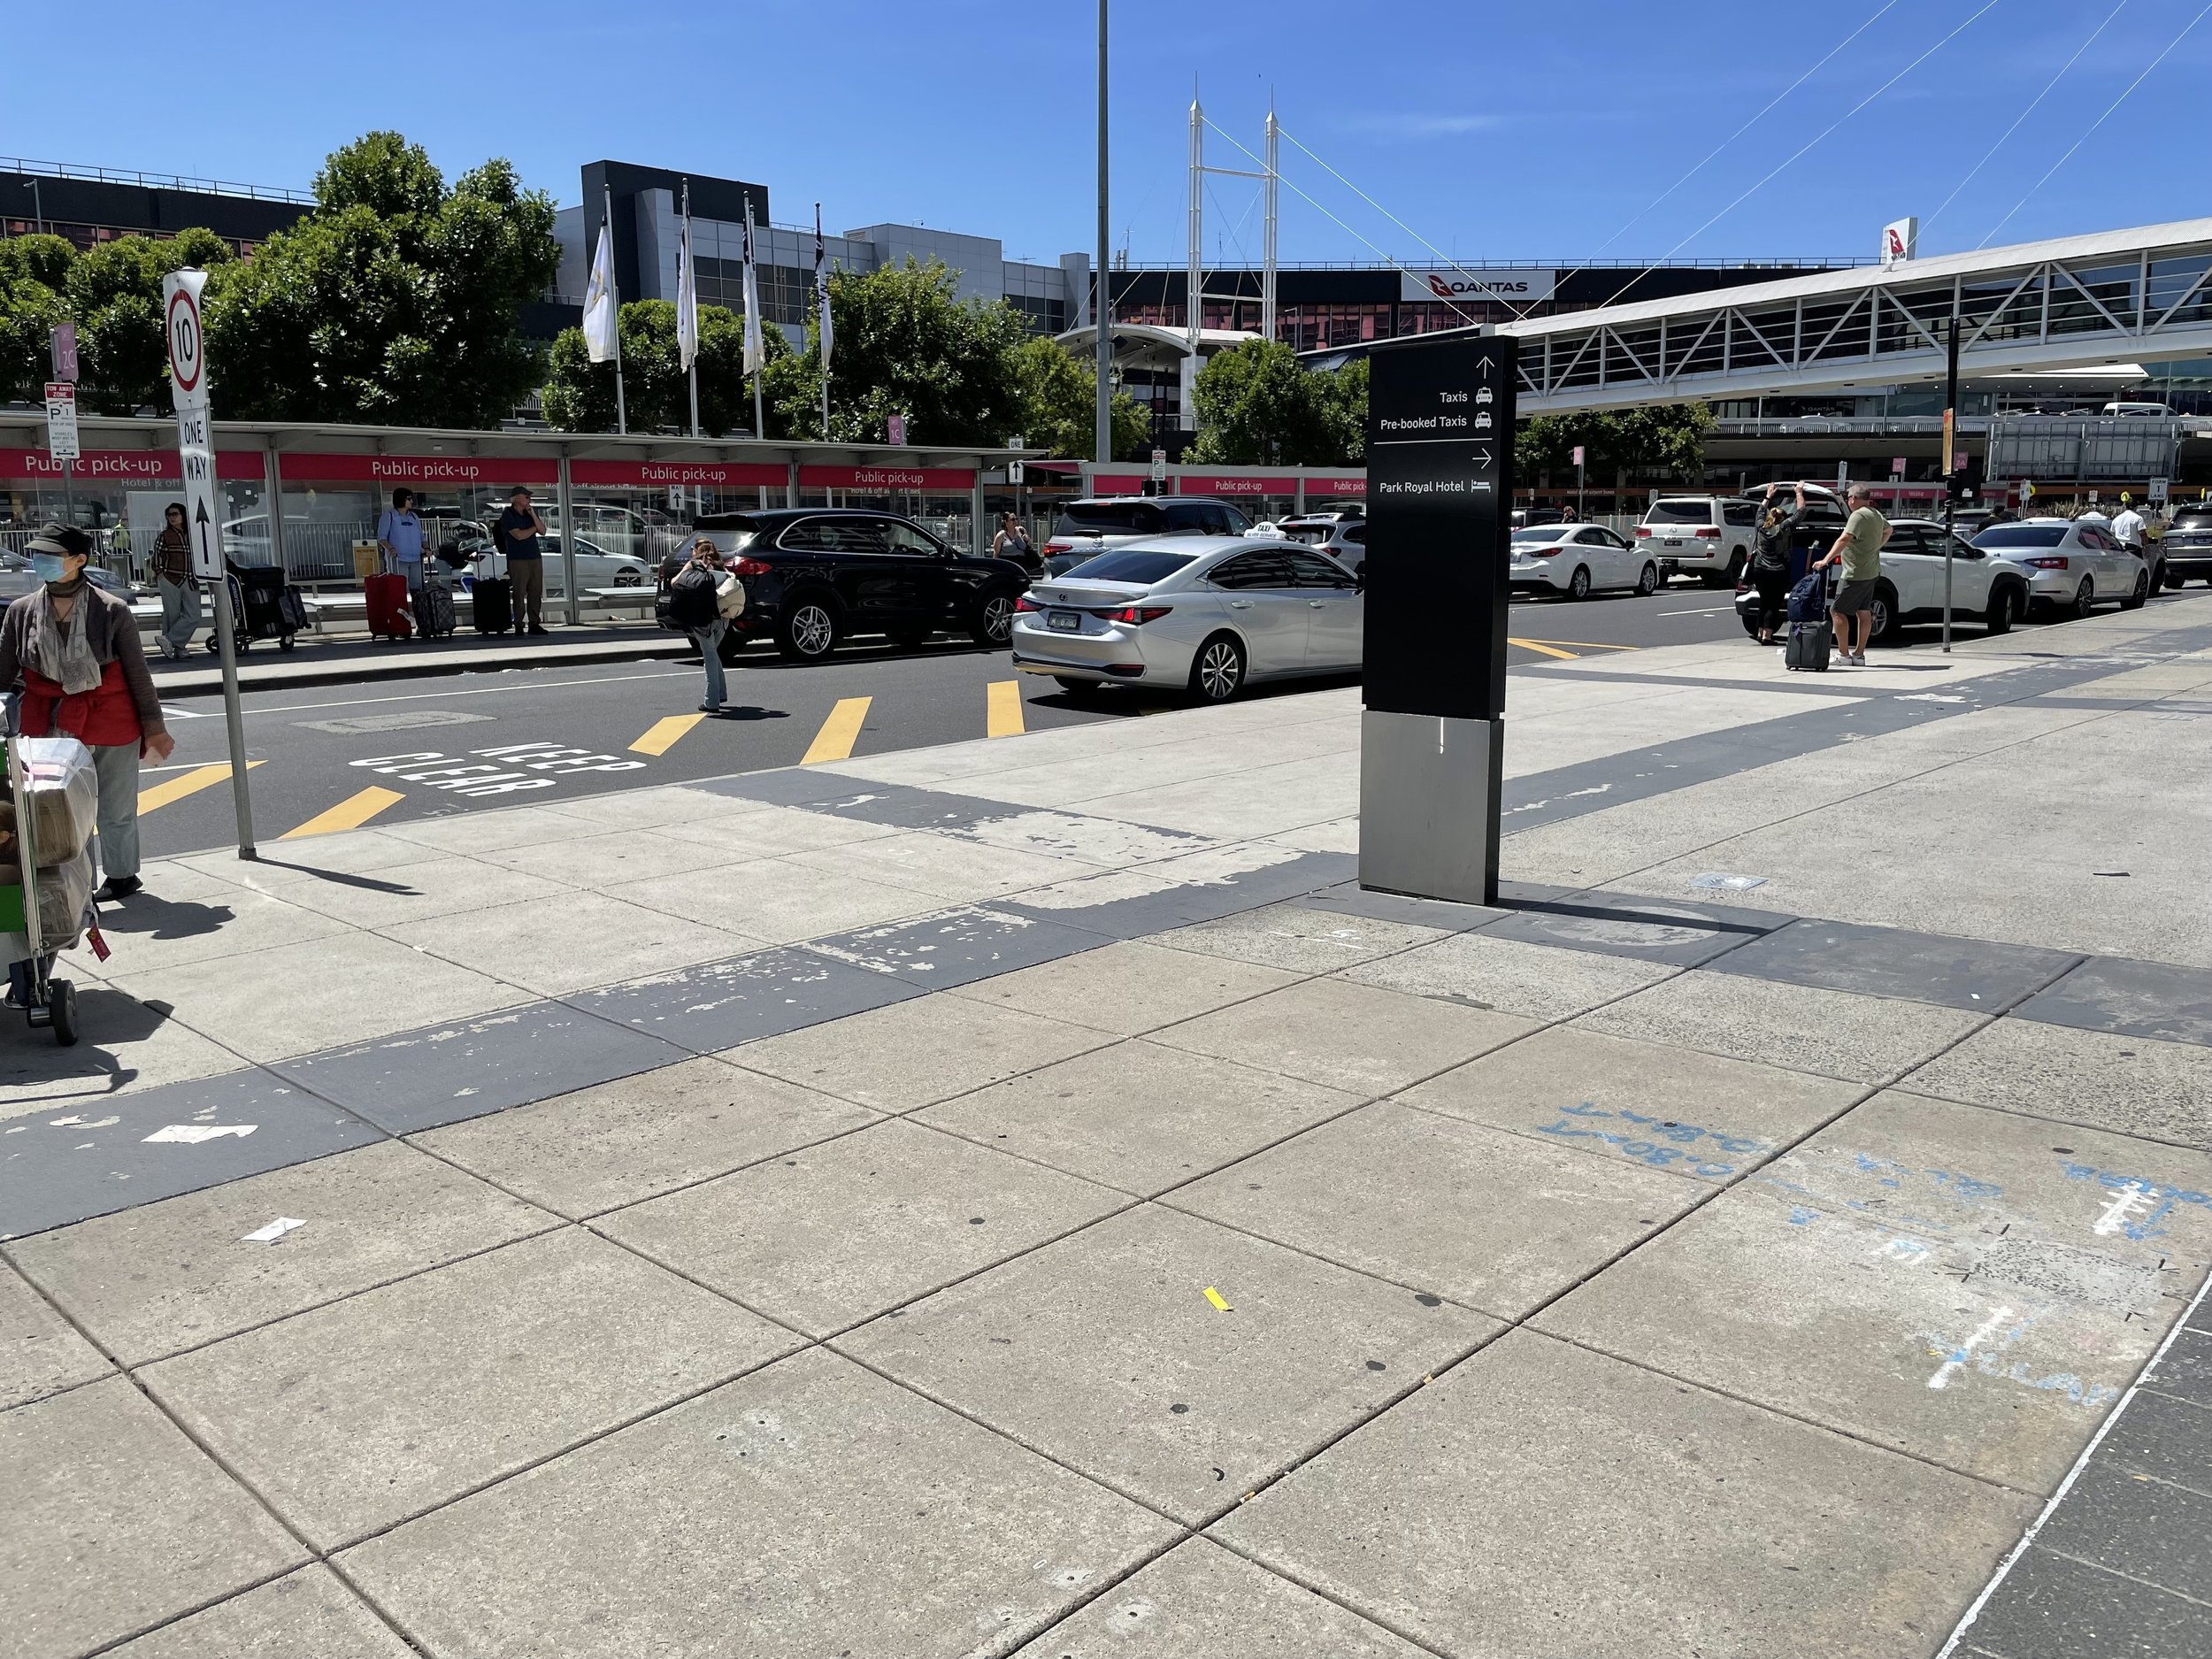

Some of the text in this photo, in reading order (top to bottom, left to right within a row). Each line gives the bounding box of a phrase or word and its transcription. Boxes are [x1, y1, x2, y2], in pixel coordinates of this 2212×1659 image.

[1450, 281, 1528, 293] QANTAS
[175, 318, 193, 363] 10
[62, 349, 75, 370] 2C
[1440, 391, 1468, 403] Taxis
[50, 408, 61, 420] P
[1380, 415, 1467, 430] Pre-booked Taxis
[184, 421, 204, 444] ONE
[891, 428, 900, 439] 1C
[25, 456, 162, 475] Pubic pick-up
[186, 457, 208, 480] WAY
[372, 461, 480, 480] Public pick-up
[641, 466, 726, 483] Public pick-up
[855, 471, 924, 486] Public pick-up
[121, 478, 150, 488] Hotel
[155, 478, 163, 488] &
[1215, 480, 1263, 492] Public pick-up
[1333, 481, 1367, 492] Public pick-
[1379, 480, 1465, 495] Park Royal Hotel
[468, 741, 648, 774] KEEP
[348, 752, 557, 797] CLEAR
